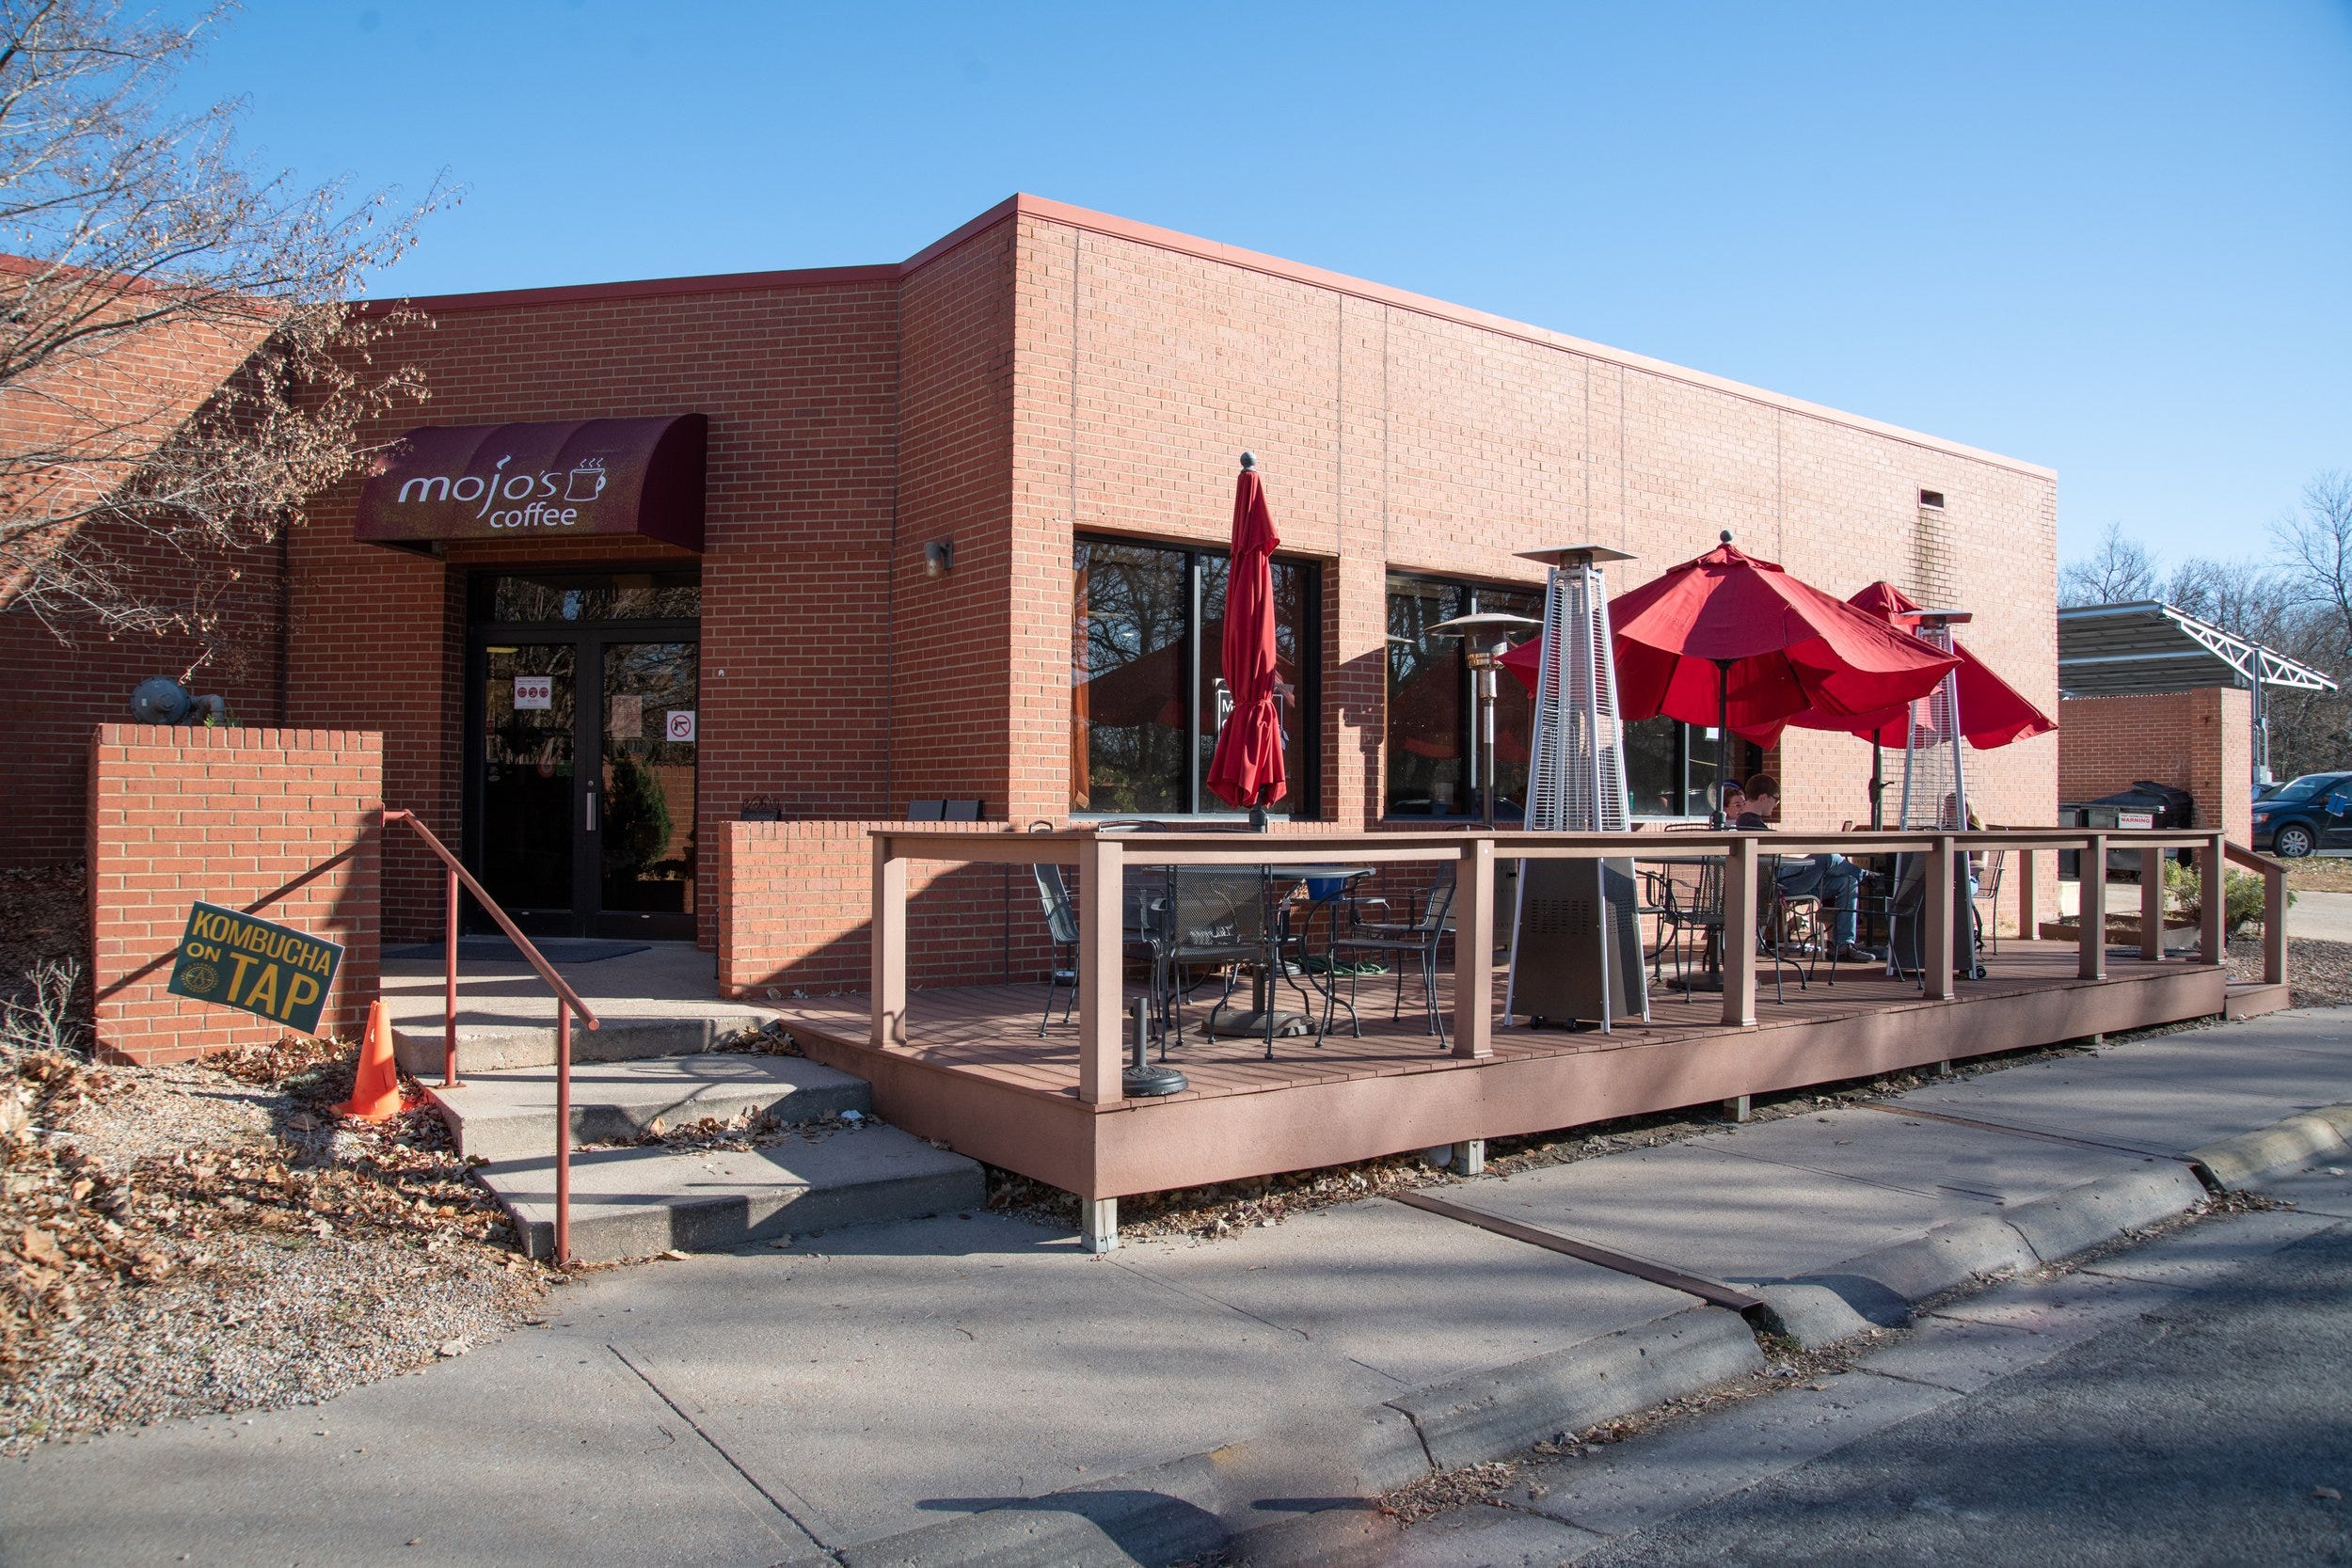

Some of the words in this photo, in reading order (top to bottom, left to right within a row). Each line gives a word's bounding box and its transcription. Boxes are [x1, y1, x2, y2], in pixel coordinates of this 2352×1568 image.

[398, 452, 563, 519] mojo's
[489, 501, 578, 529] coffee
[186, 942, 222, 963] ON
[192, 911, 331, 976] KOMBUCHA
[227, 952, 320, 1021] TAP
